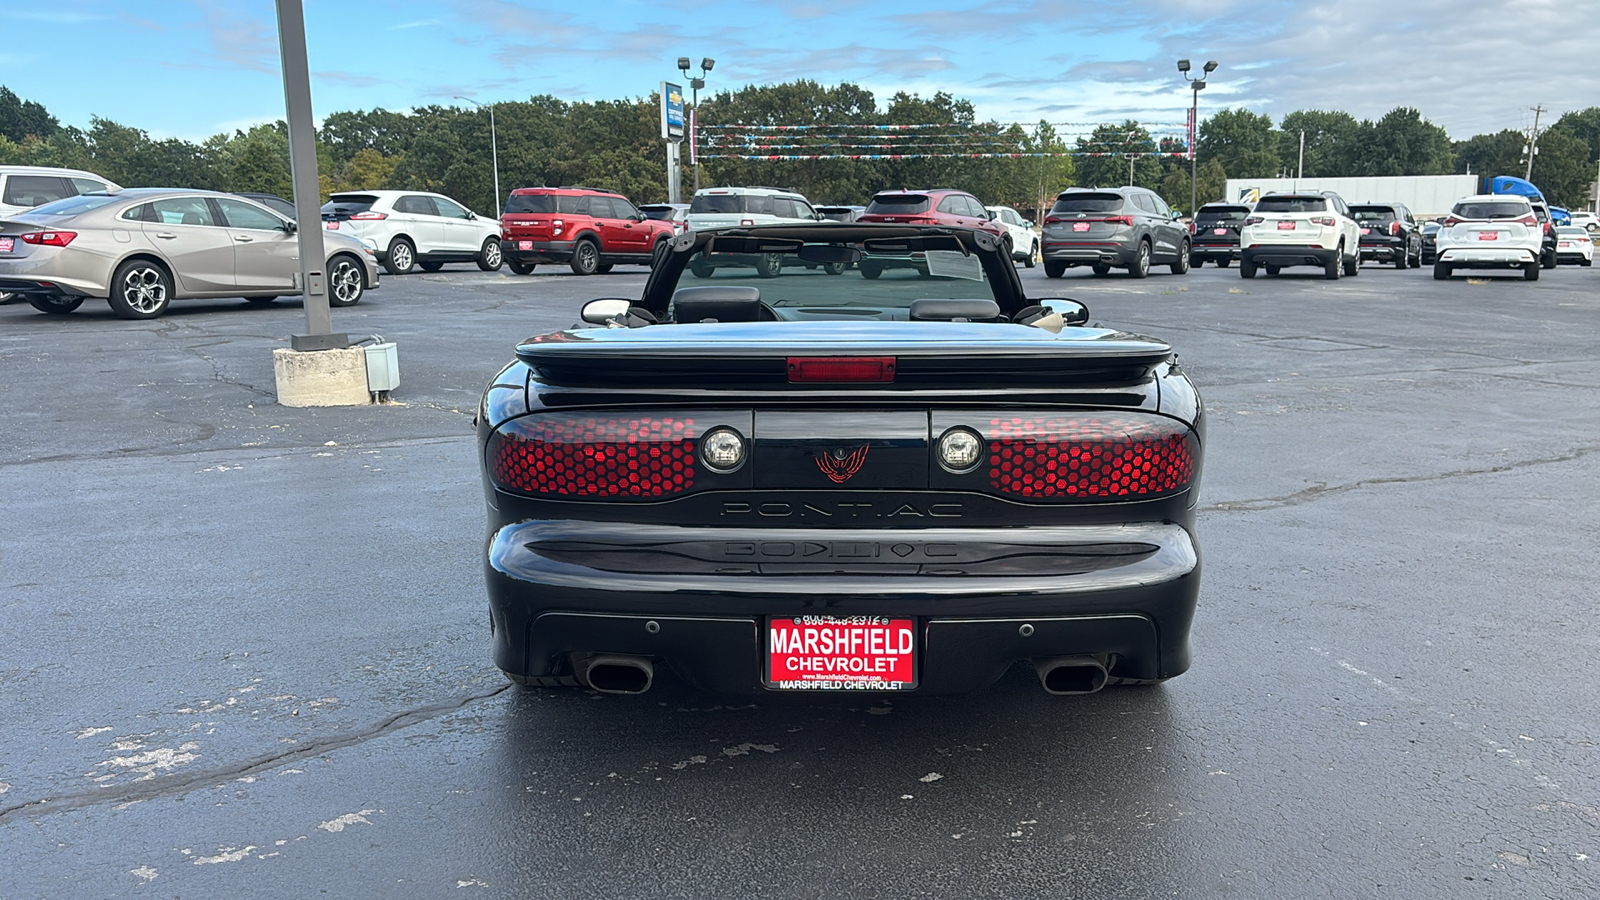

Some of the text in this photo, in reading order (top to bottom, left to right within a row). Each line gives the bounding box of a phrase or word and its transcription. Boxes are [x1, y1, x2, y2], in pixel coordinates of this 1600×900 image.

[720, 503, 962, 517] PONTIAC
[770, 628, 913, 655] MARSHFIELD
[786, 656, 898, 672] CHEVROLET
[780, 680, 903, 690] MARSHFIELD CHEVROLET
